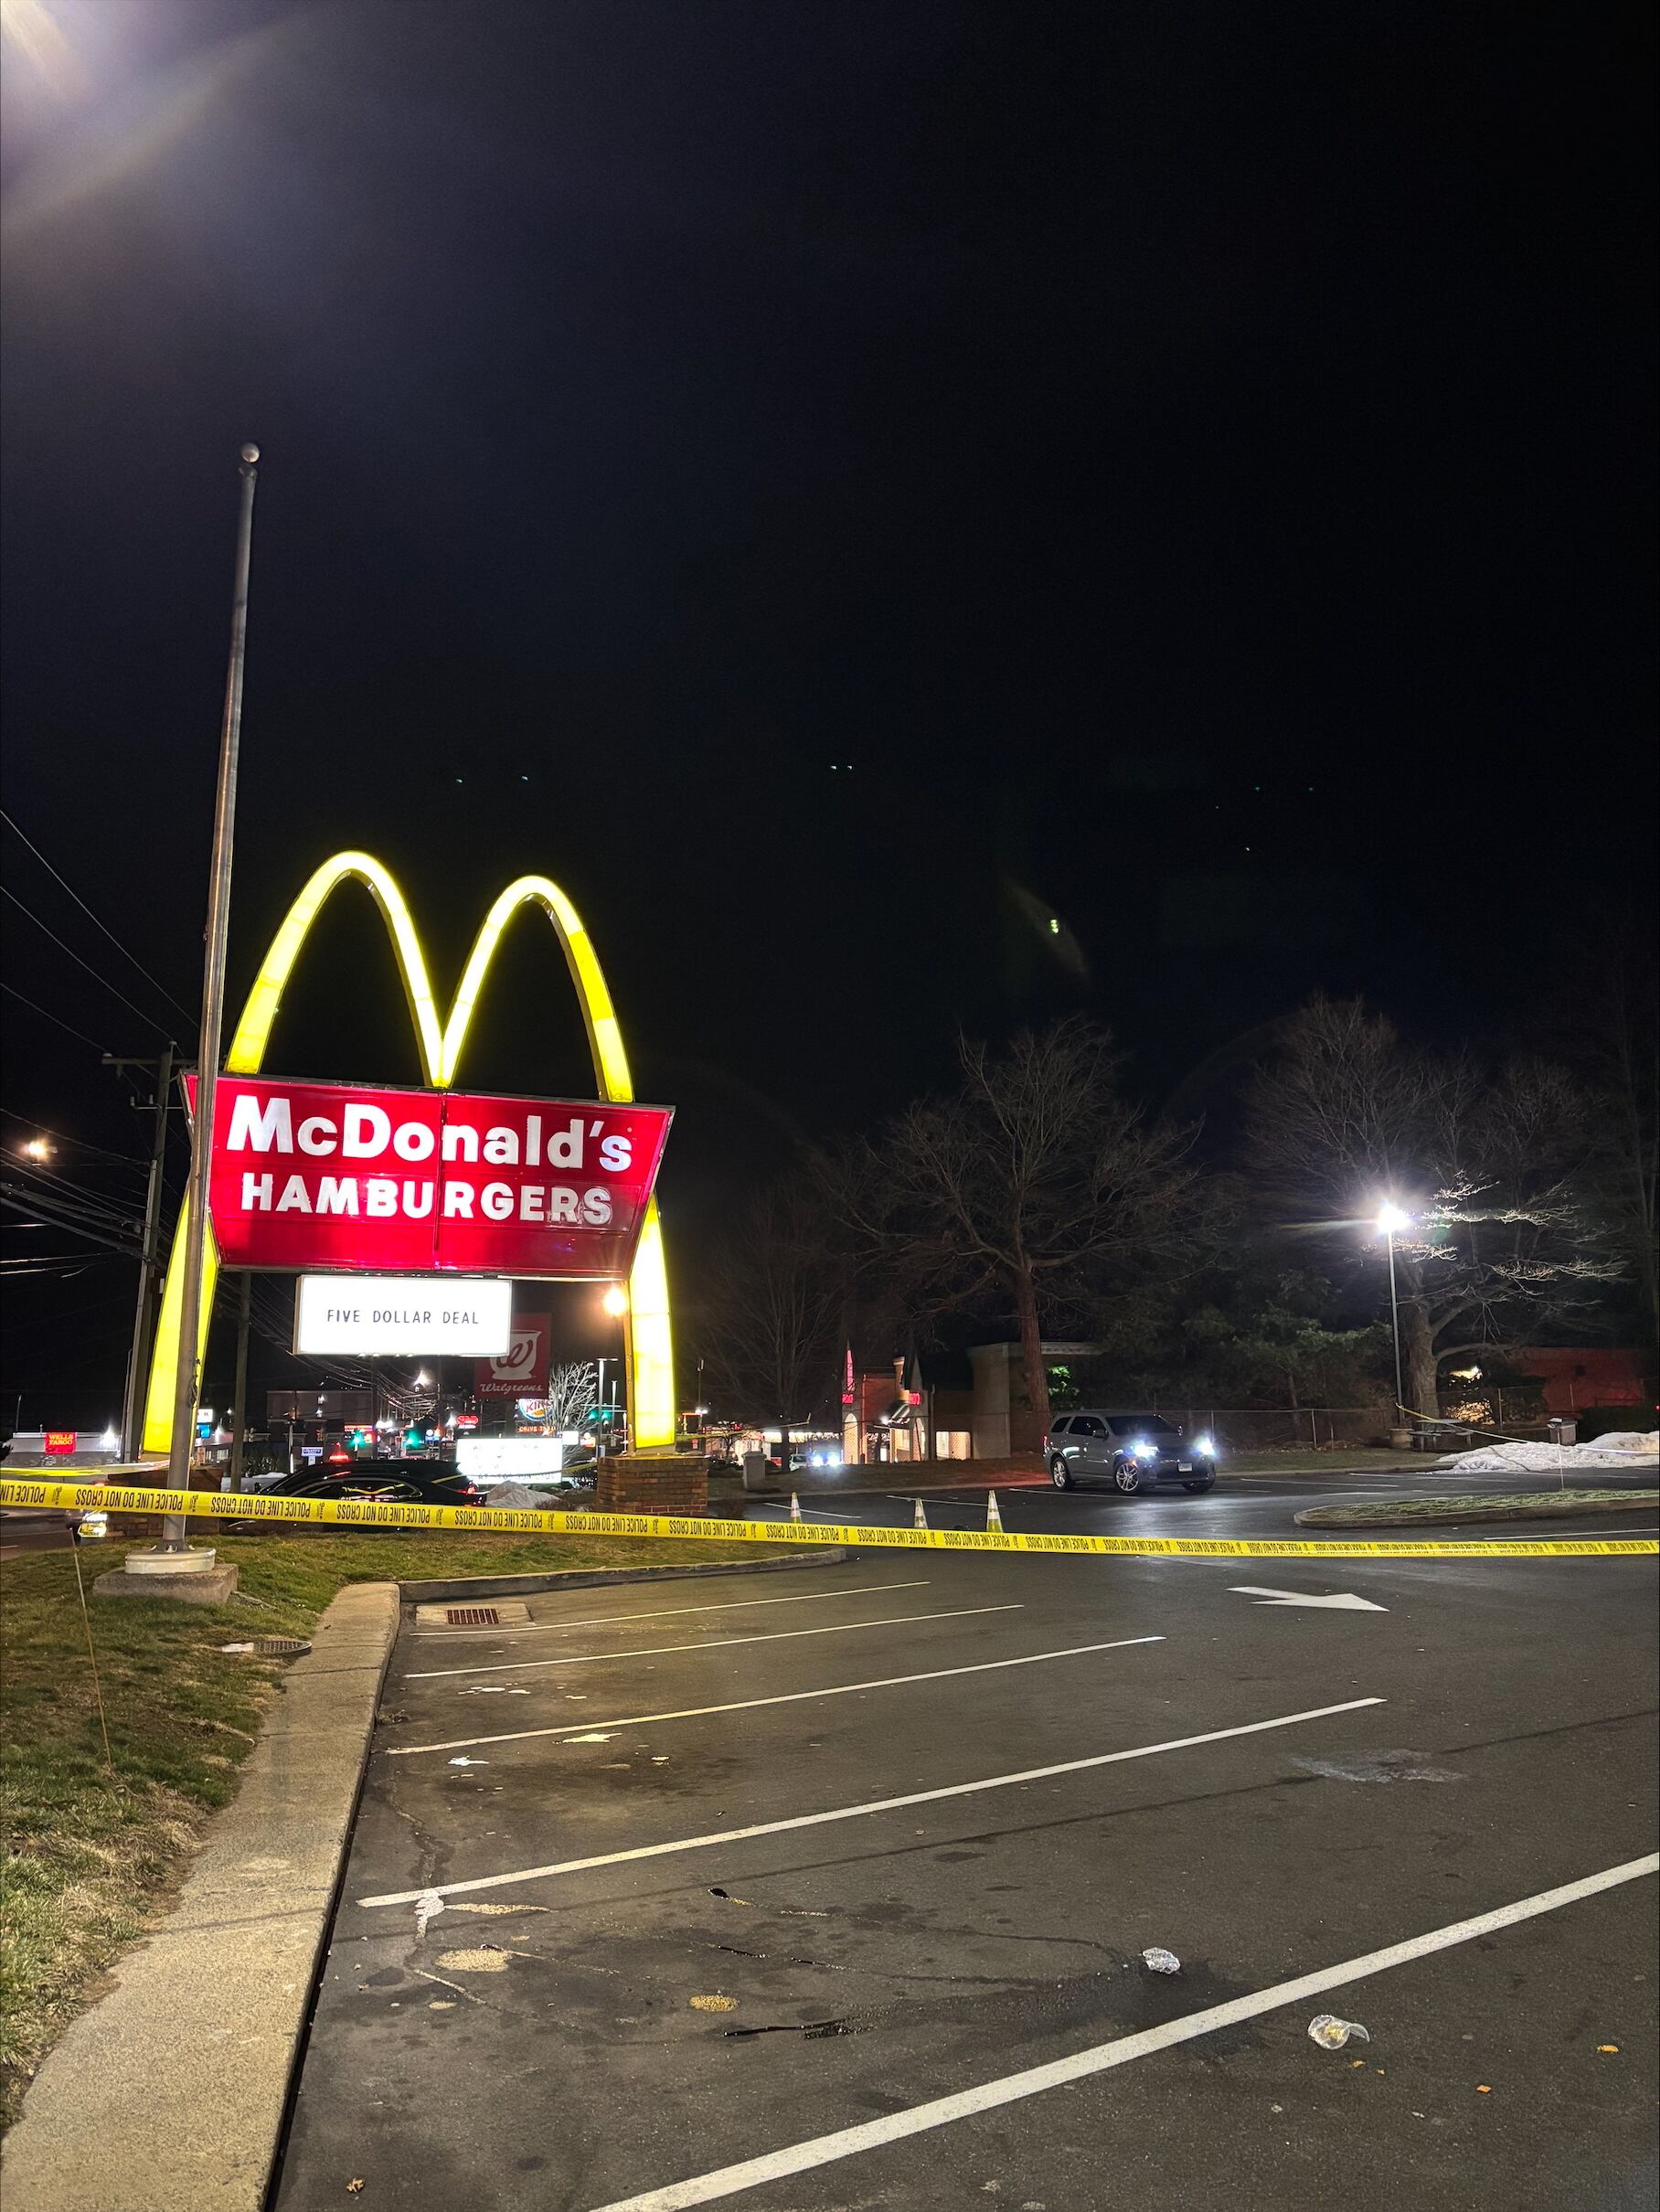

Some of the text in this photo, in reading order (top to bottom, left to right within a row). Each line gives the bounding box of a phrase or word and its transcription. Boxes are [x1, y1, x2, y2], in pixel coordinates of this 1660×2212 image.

[226, 1094, 633, 1172] McDonald's
[240, 1172, 612, 1225] HAMBURGERS
[327, 1309, 479, 1324] FIVE DOLLAR DEAL
[479, 1383, 544, 1395] Walgreens
[0, 1483, 14, 1501] LIN
[15, 1484, 47, 1504] POLICE
[75, 1488, 102, 1506] CROSS
[103, 1490, 121, 1507] NOT
[122, 1491, 134, 1508] DO
[135, 1492, 154, 1509] LINE
[154, 1493, 183, 1511] POLICE
[210, 1496, 237, 1514] CROSS
[237, 1497, 253, 1515] NOT
[254, 1498, 265, 1515] DO
[266, 1499, 283, 1516] LINE
[284, 1500, 310, 1517] POLICE
[336, 1504, 360, 1520] CROSS
[361, 1505, 376, 1521] NOT
[378, 1505, 388, 1521] DO
[388, 1505, 404, 1522] LINE
[406, 1506, 430, 1524] POLICE
[454, 1509, 476, 1525] CROSS
[477, 1511, 492, 1526] NOT
[493, 1511, 503, 1526] DO
[504, 1512, 518, 1527] LINE
[519, 1513, 542, 1528] POLICE
[565, 1515, 587, 1530] CROSS
[587, 1515, 600, 1530] NOT
[601, 1516, 610, 1531] DO
[612, 1516, 625, 1532] LINE
[626, 1517, 647, 1533] POLICE
[668, 1519, 689, 1535] CROSS
[690, 1520, 701, 1535] NOT
[702, 1521, 711, 1536] DO
[712, 1522, 725, 1536] LINE
[725, 1522, 746, 1537] POLICE
[765, 1524, 784, 1538] CROSS
[786, 1525, 797, 1539] NOT
[798, 1526, 806, 1539] DO
[806, 1526, 819, 1540] LINE
[819, 1526, 838, 1541] POLICE
[857, 1528, 926, 1544] POLICE LINE DO NOT CROSS
